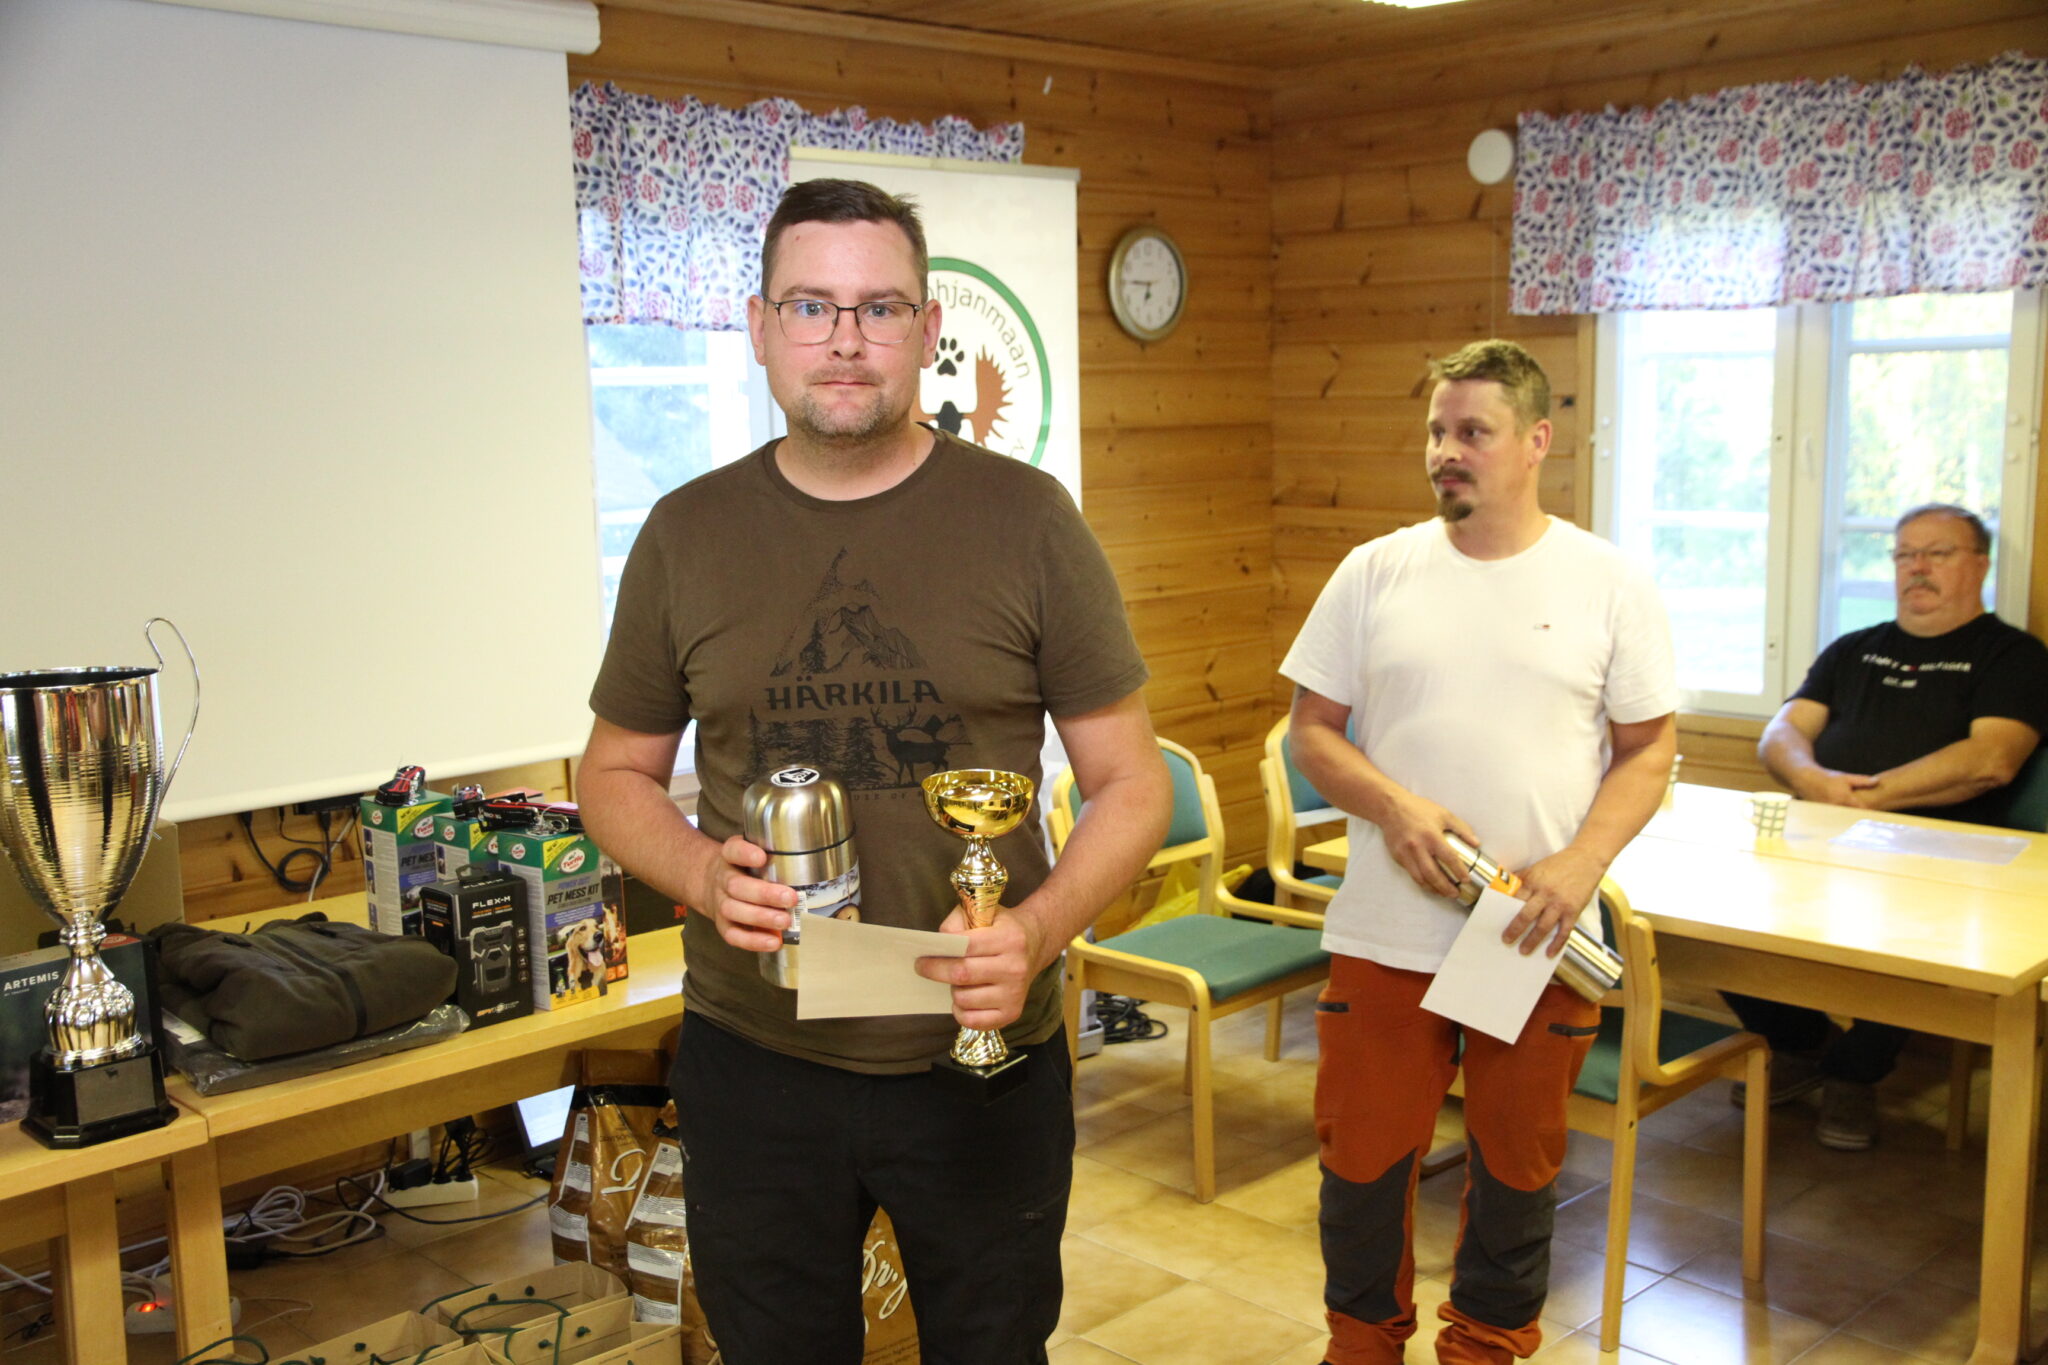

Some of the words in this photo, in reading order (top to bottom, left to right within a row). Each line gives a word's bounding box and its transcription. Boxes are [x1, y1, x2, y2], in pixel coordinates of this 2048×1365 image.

[764, 675, 945, 711] HÄRKILA
[471, 895, 512, 910] FLEX-M
[546, 891, 564, 906] PET
[564, 886, 587, 902] MESS
[587, 883, 601, 896] KIT
[3, 970, 60, 992] ARTEMIS
